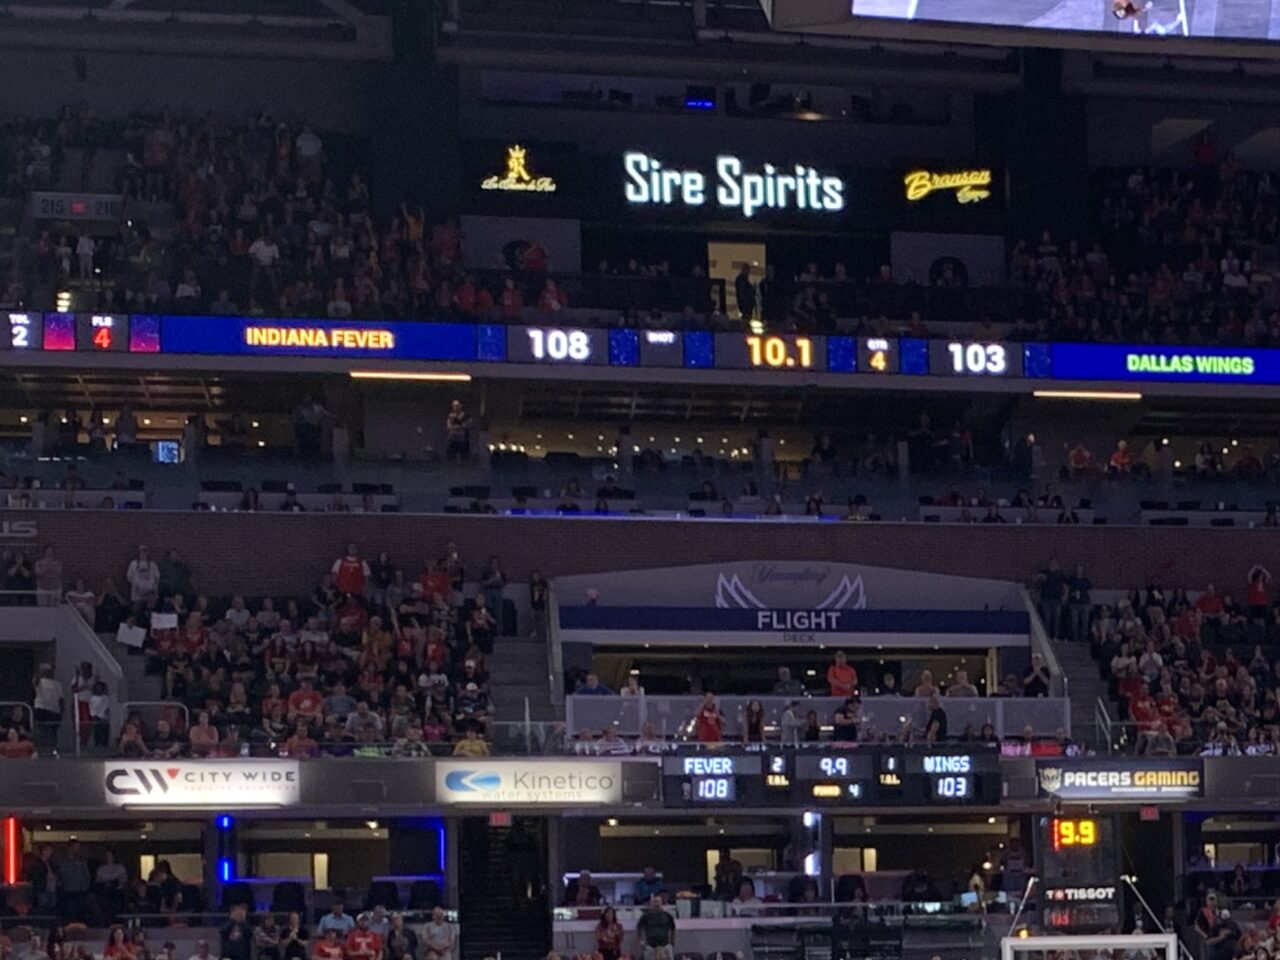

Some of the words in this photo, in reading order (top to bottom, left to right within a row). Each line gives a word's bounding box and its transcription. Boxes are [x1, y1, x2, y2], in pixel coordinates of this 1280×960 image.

[624, 151, 706, 205] Sire
[716, 155, 846, 218] Spirits
[904, 169, 993, 201] Branson
[12, 326, 29, 347] 2
[93, 327, 112, 349] 4
[245, 327, 329, 347] INDIANA
[331, 330, 396, 349] FEVER
[528, 329, 591, 360] 108
[746, 336, 812, 368] 10.1
[869, 350, 888, 372] 4
[948, 342, 1007, 374] 103
[1126, 353, 1194, 372] DALLAS
[1196, 356, 1255, 374] WINGS
[757, 611, 841, 630] FLIGHT
[683, 757, 733, 775] FEVER
[772, 757, 783, 773] 2
[820, 757, 848, 777] 9.9
[887, 757, 896, 771] 1
[923, 756, 971, 773] WINGS
[184, 771, 233, 782] CITY
[242, 771, 296, 782] WIDE
[513, 771, 614, 791] Kinetico
[1064, 771, 1131, 787] PACERS
[1133, 770, 1200, 787] GAMING
[698, 778, 728, 799] 108
[848, 783, 860, 798] 4
[937, 777, 968, 797] 103
[1060, 820, 1097, 845] 9.9
[1064, 887, 1116, 900] TISSOT
